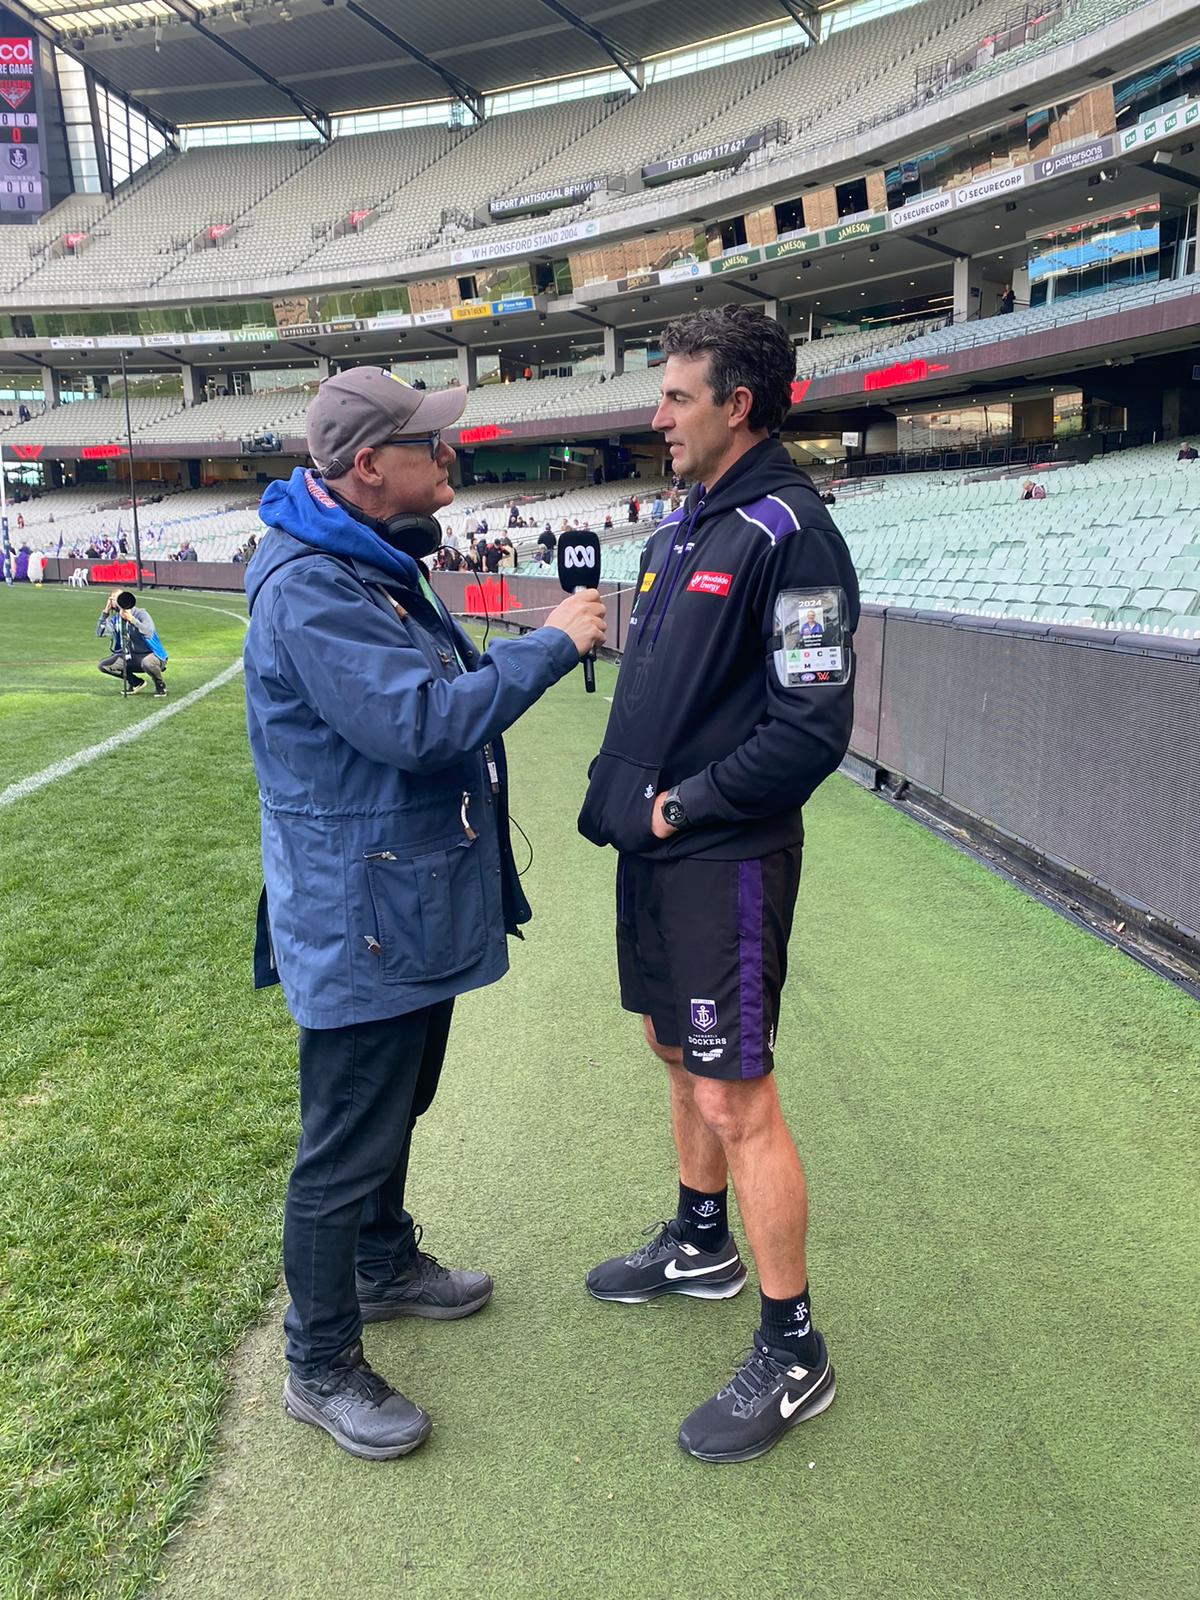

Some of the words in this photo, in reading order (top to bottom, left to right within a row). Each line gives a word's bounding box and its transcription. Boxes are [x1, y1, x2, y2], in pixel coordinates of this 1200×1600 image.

[9, 64, 33, 75] GAME
[2, 113, 8, 125] 0
[24, 113, 30, 125] 0
[12, 127, 21, 144] 0
[667, 156, 688, 171] TEXT
[693, 148, 713, 163] 0409
[715, 143, 730, 157] 117
[731, 138, 746, 153] 621
[1055, 146, 1103, 170] pattersons
[7, 181, 13, 193] 0
[28, 181, 34, 193] 0
[968, 175, 1022, 200] SECURECORP
[18, 195, 25, 209] 0
[490, 197, 519, 211] REPORT
[519, 186, 564, 207] ANTISOCIAL
[903, 198, 950, 221] SECURECORP
[838, 222, 872, 241] JAMESON
[472, 248, 480, 259] W
[481, 246, 487, 257] H
[489, 238, 532, 256] PONSFORD
[534, 233, 558, 249] STAND
[560, 227, 579, 243] 2004
[777, 239, 807, 256] JAMESON
[722, 255, 750, 271] JAMESON
[700, 582, 721, 592] Energy
[702, 574, 729, 585] Woodside
[798, 599, 822, 608] 2024
[688, 1036, 728, 1046] DOCKERS
